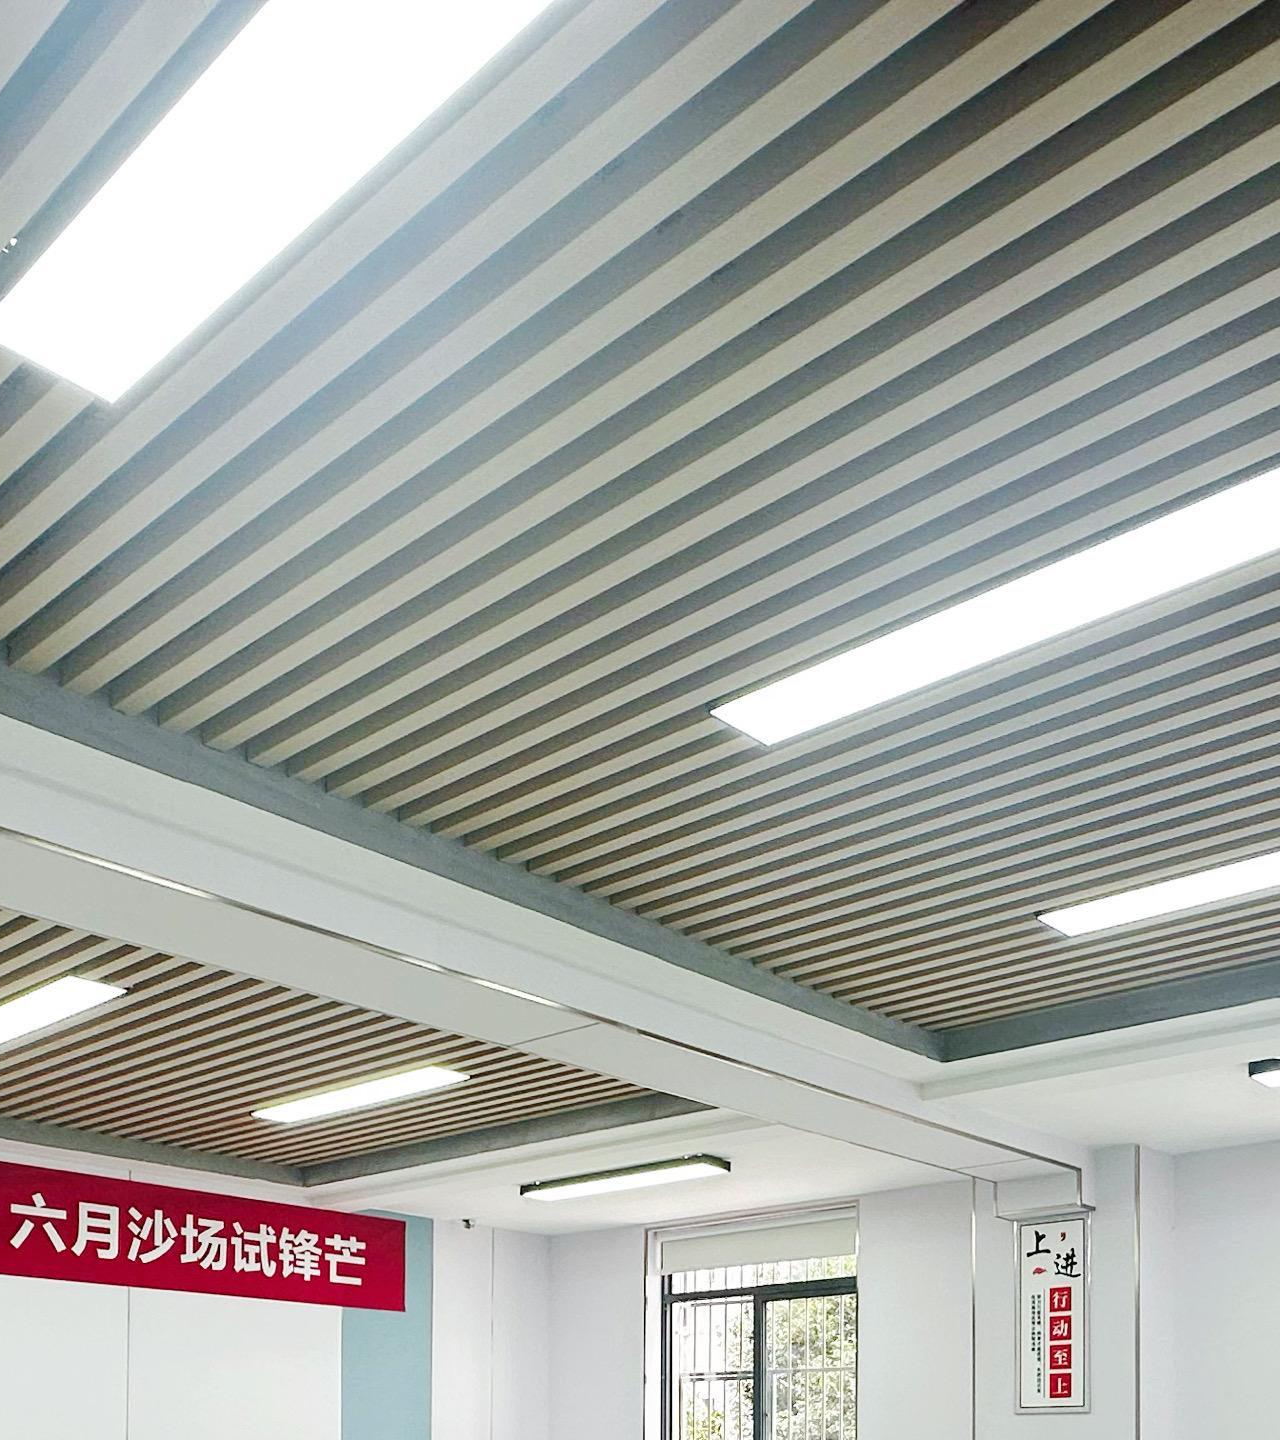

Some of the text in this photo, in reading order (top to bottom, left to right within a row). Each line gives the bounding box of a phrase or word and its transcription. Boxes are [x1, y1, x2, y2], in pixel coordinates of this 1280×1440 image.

[9, 1192, 367, 1286] 六月沙场试锋芒
[1026, 1230, 1081, 1278] 上进
[1051, 1290, 1069, 1395] 行动至上
